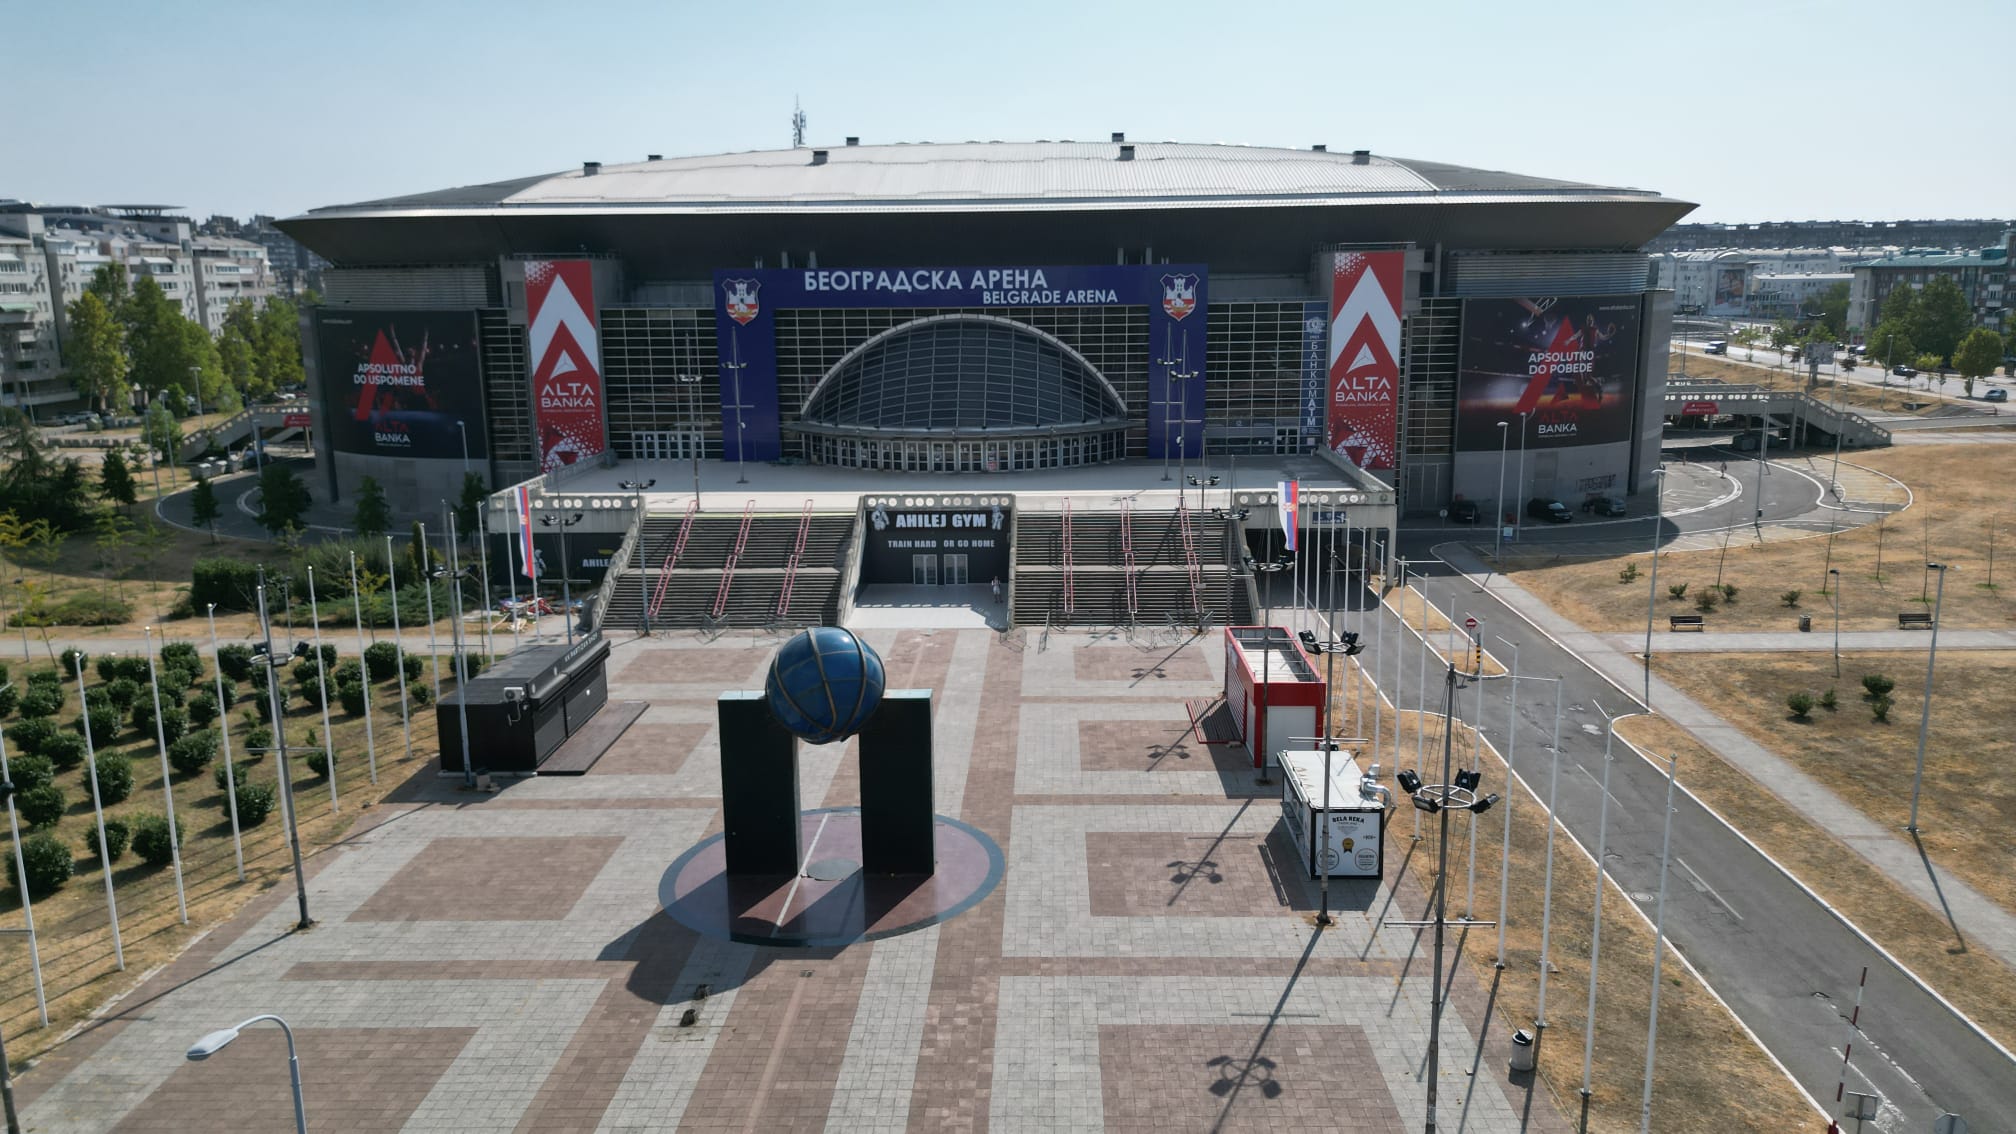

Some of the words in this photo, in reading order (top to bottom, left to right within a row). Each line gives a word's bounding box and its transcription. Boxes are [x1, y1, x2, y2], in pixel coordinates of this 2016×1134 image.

[804, 270, 963, 292] БЕОГРАДСКА
[970, 268, 1048, 289] АРЕНА
[982, 290, 1061, 305] BELGRADE
[1065, 288, 1118, 303] ARENA
[1528, 350, 1594, 363] APSOLUTNO
[357, 362, 417, 375] APSOLUTNO
[1529, 364, 1546, 375] DO
[1550, 363, 1593, 374] POBEDE
[353, 373, 367, 385] DO
[368, 374, 425, 387] USPOMENE
[1336, 376, 1391, 390] ALTA
[541, 382, 595, 396] ALTA
[541, 397, 595, 408] BANKA
[1335, 390, 1392, 403] BANKA
[1538, 423, 1578, 434] BANKA
[374, 432, 411, 443] BANKA
[896, 514, 947, 528] AHILEJ
[952, 514, 987, 528] GYM
[888, 540, 912, 548] TRAIN
[914, 540, 937, 548] HARD
[971, 540, 996, 548] HOME
[582, 559, 610, 567] AHILE
[1348, 816, 1365, 824] REKA
